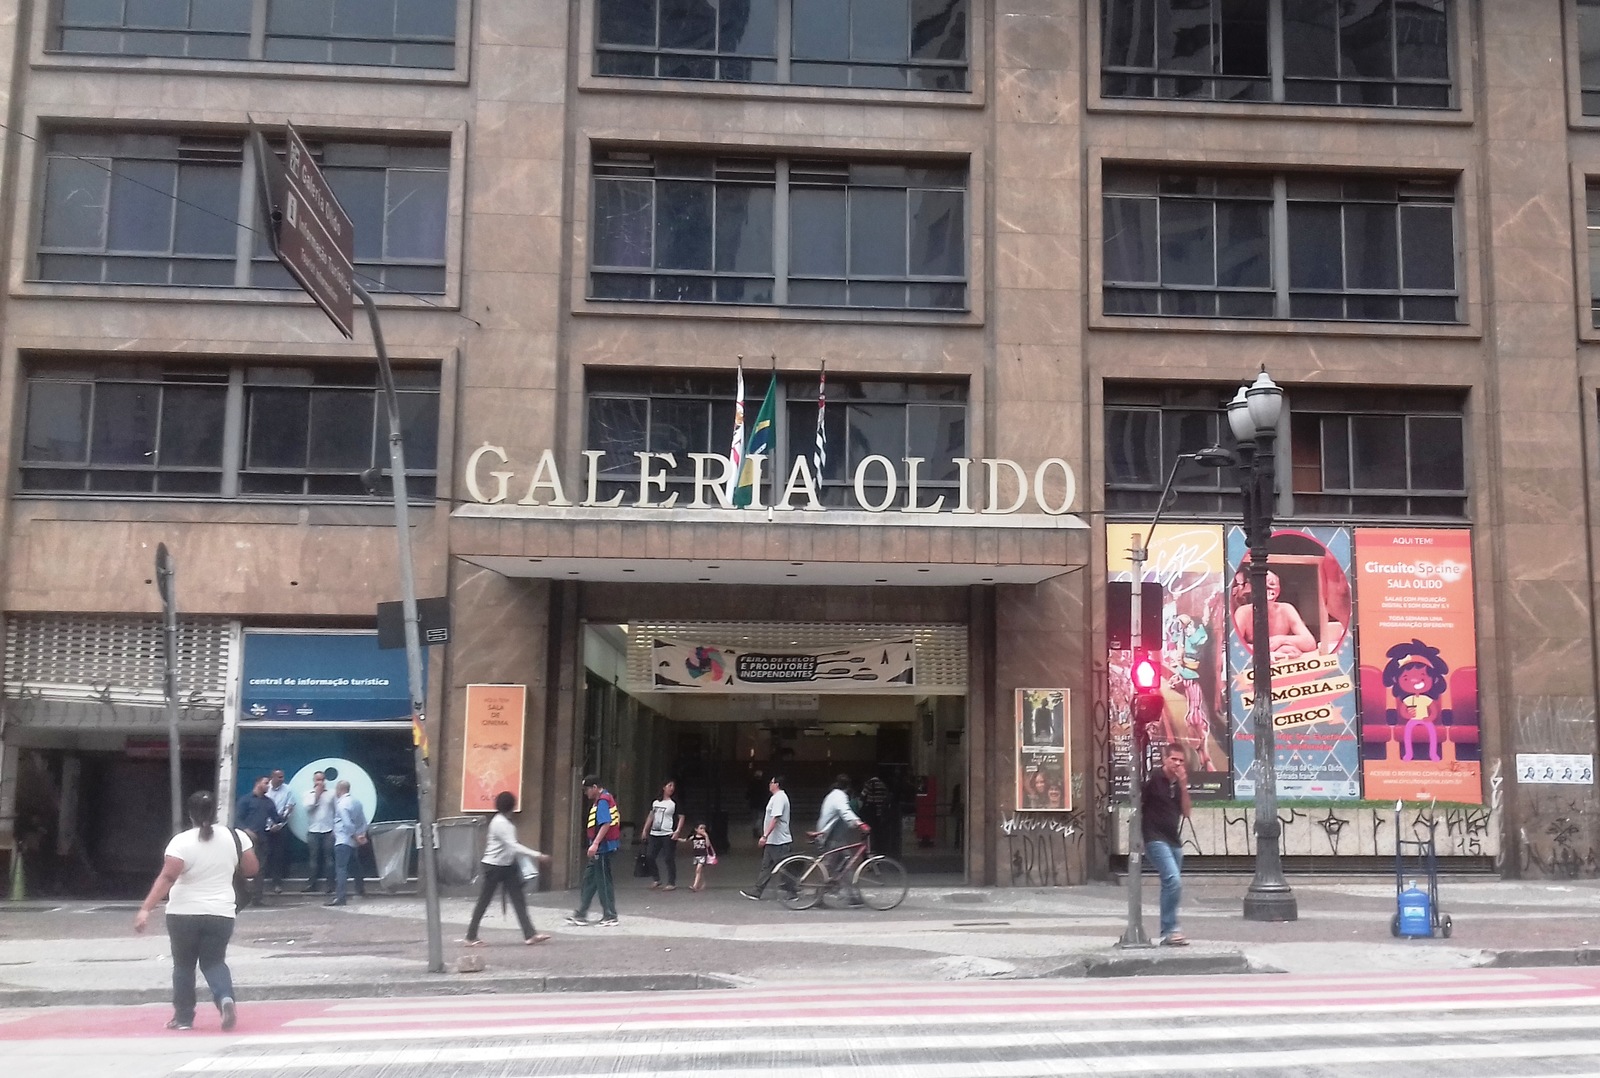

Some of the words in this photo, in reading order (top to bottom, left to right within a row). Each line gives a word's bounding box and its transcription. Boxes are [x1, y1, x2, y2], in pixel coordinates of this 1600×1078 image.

[301, 164, 325, 212] Galeria
[465, 441, 827, 511] GALERIA
[853, 455, 1076, 516] OLIDO
[1392, 537, 1413, 545] AQUI
[1414, 537, 1434, 545] TEM!
[1364, 561, 1415, 573] Circuito
[1387, 578, 1411, 589] SALA
[1412, 579, 1443, 589] OLIDO
[1246, 659, 1321, 681] CNTRO
[1323, 659, 1338, 668] DE
[249, 677, 282, 685] central
[284, 677, 296, 685] de
[297, 677, 349, 687] informação
[351, 677, 390, 686] turística
[1244, 681, 1333, 707] MMÓRIA
[1335, 682, 1350, 690] DO
[1274, 707, 1331, 727] CIRCO
